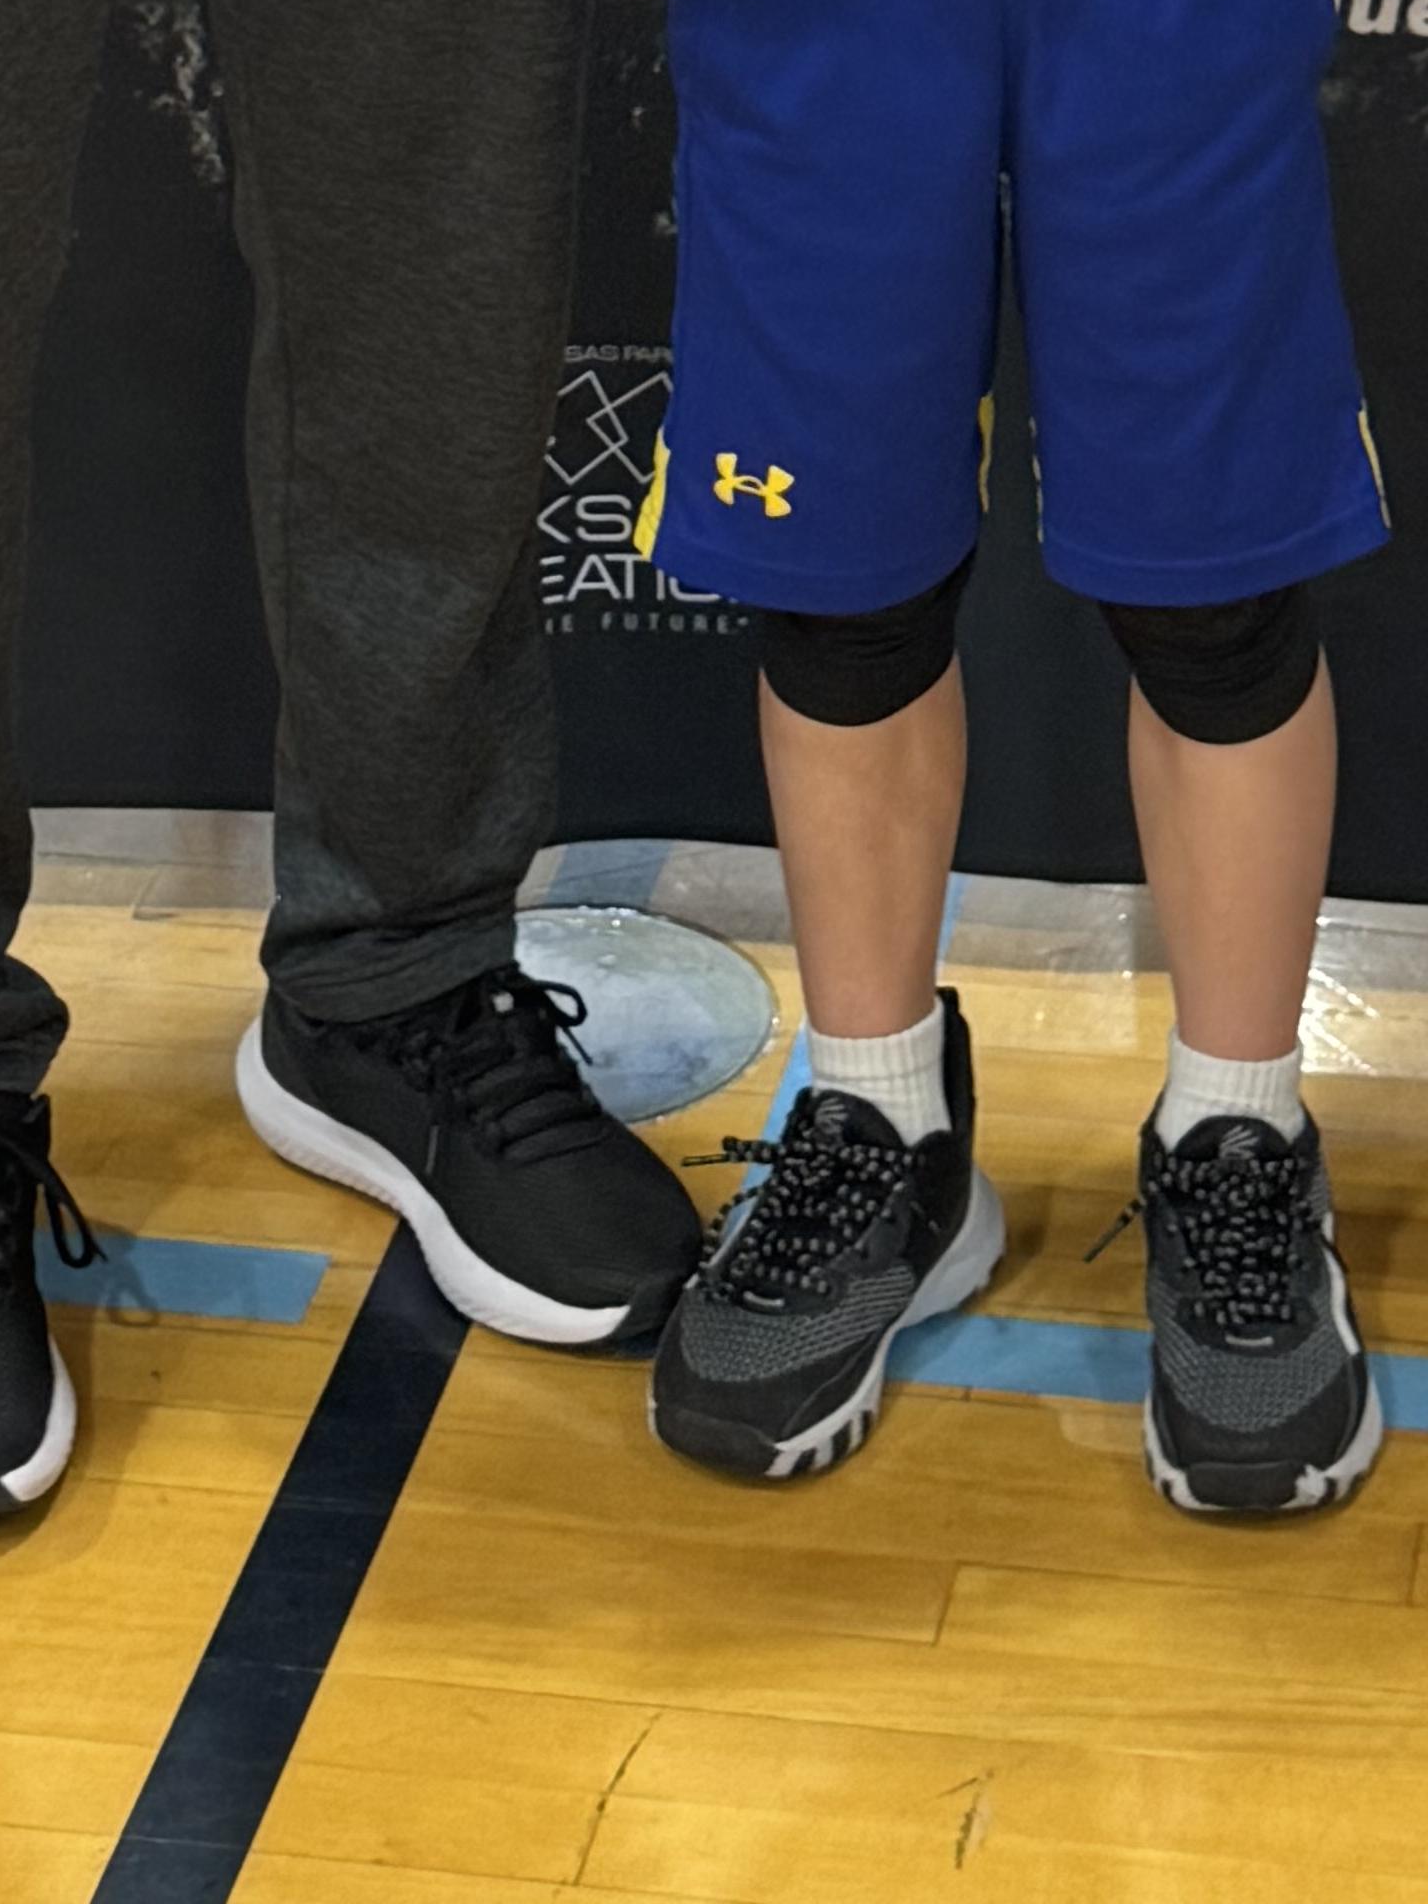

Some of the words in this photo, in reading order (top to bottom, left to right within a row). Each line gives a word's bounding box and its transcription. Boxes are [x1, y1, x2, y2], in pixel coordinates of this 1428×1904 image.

[564, 344, 620, 364] SAS
[622, 344, 674, 364] PAR
[537, 493, 633, 545] KS
